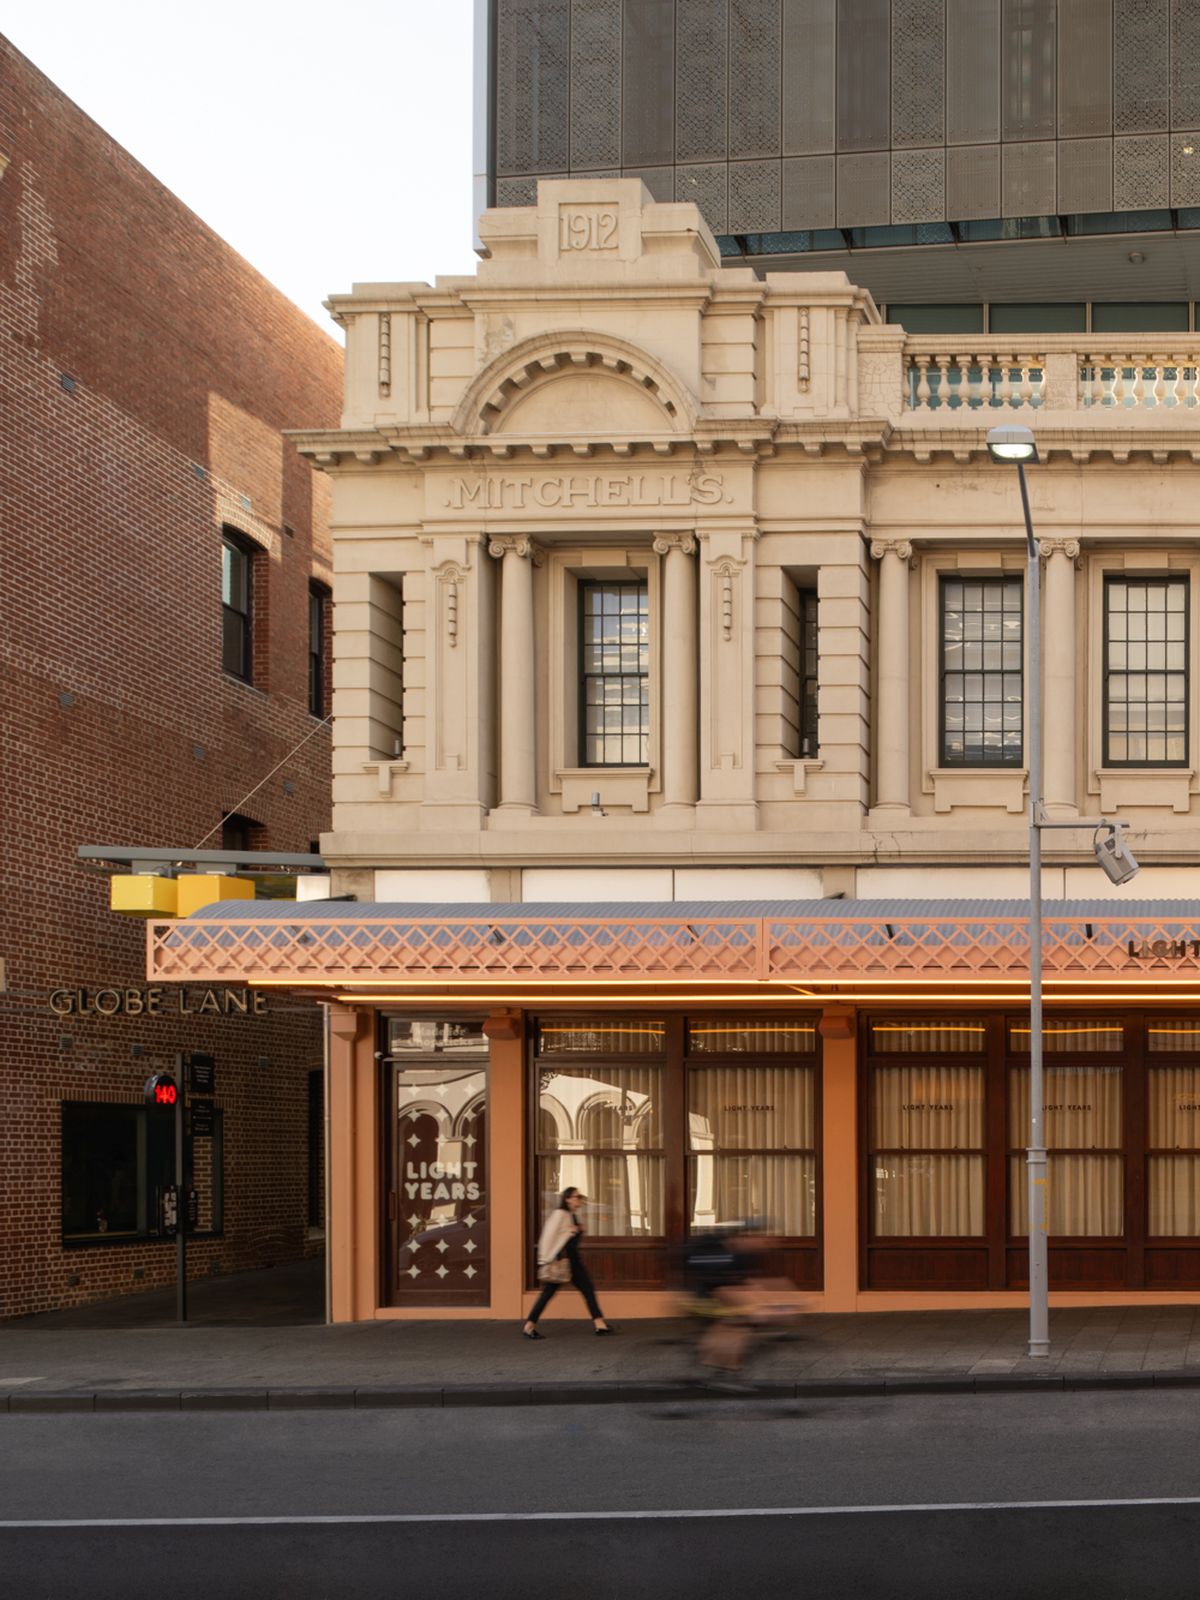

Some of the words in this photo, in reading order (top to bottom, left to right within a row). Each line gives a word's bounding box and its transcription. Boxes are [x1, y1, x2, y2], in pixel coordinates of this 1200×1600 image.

[559, 213, 619, 251] 1912
[50, 988, 163, 1015] GLOBE
[179, 988, 269, 1014] LANE
[155, 1084, 177, 1105] 140
[406, 1161, 478, 1180] LIGHT
[404, 1182, 480, 1200] YEARS
